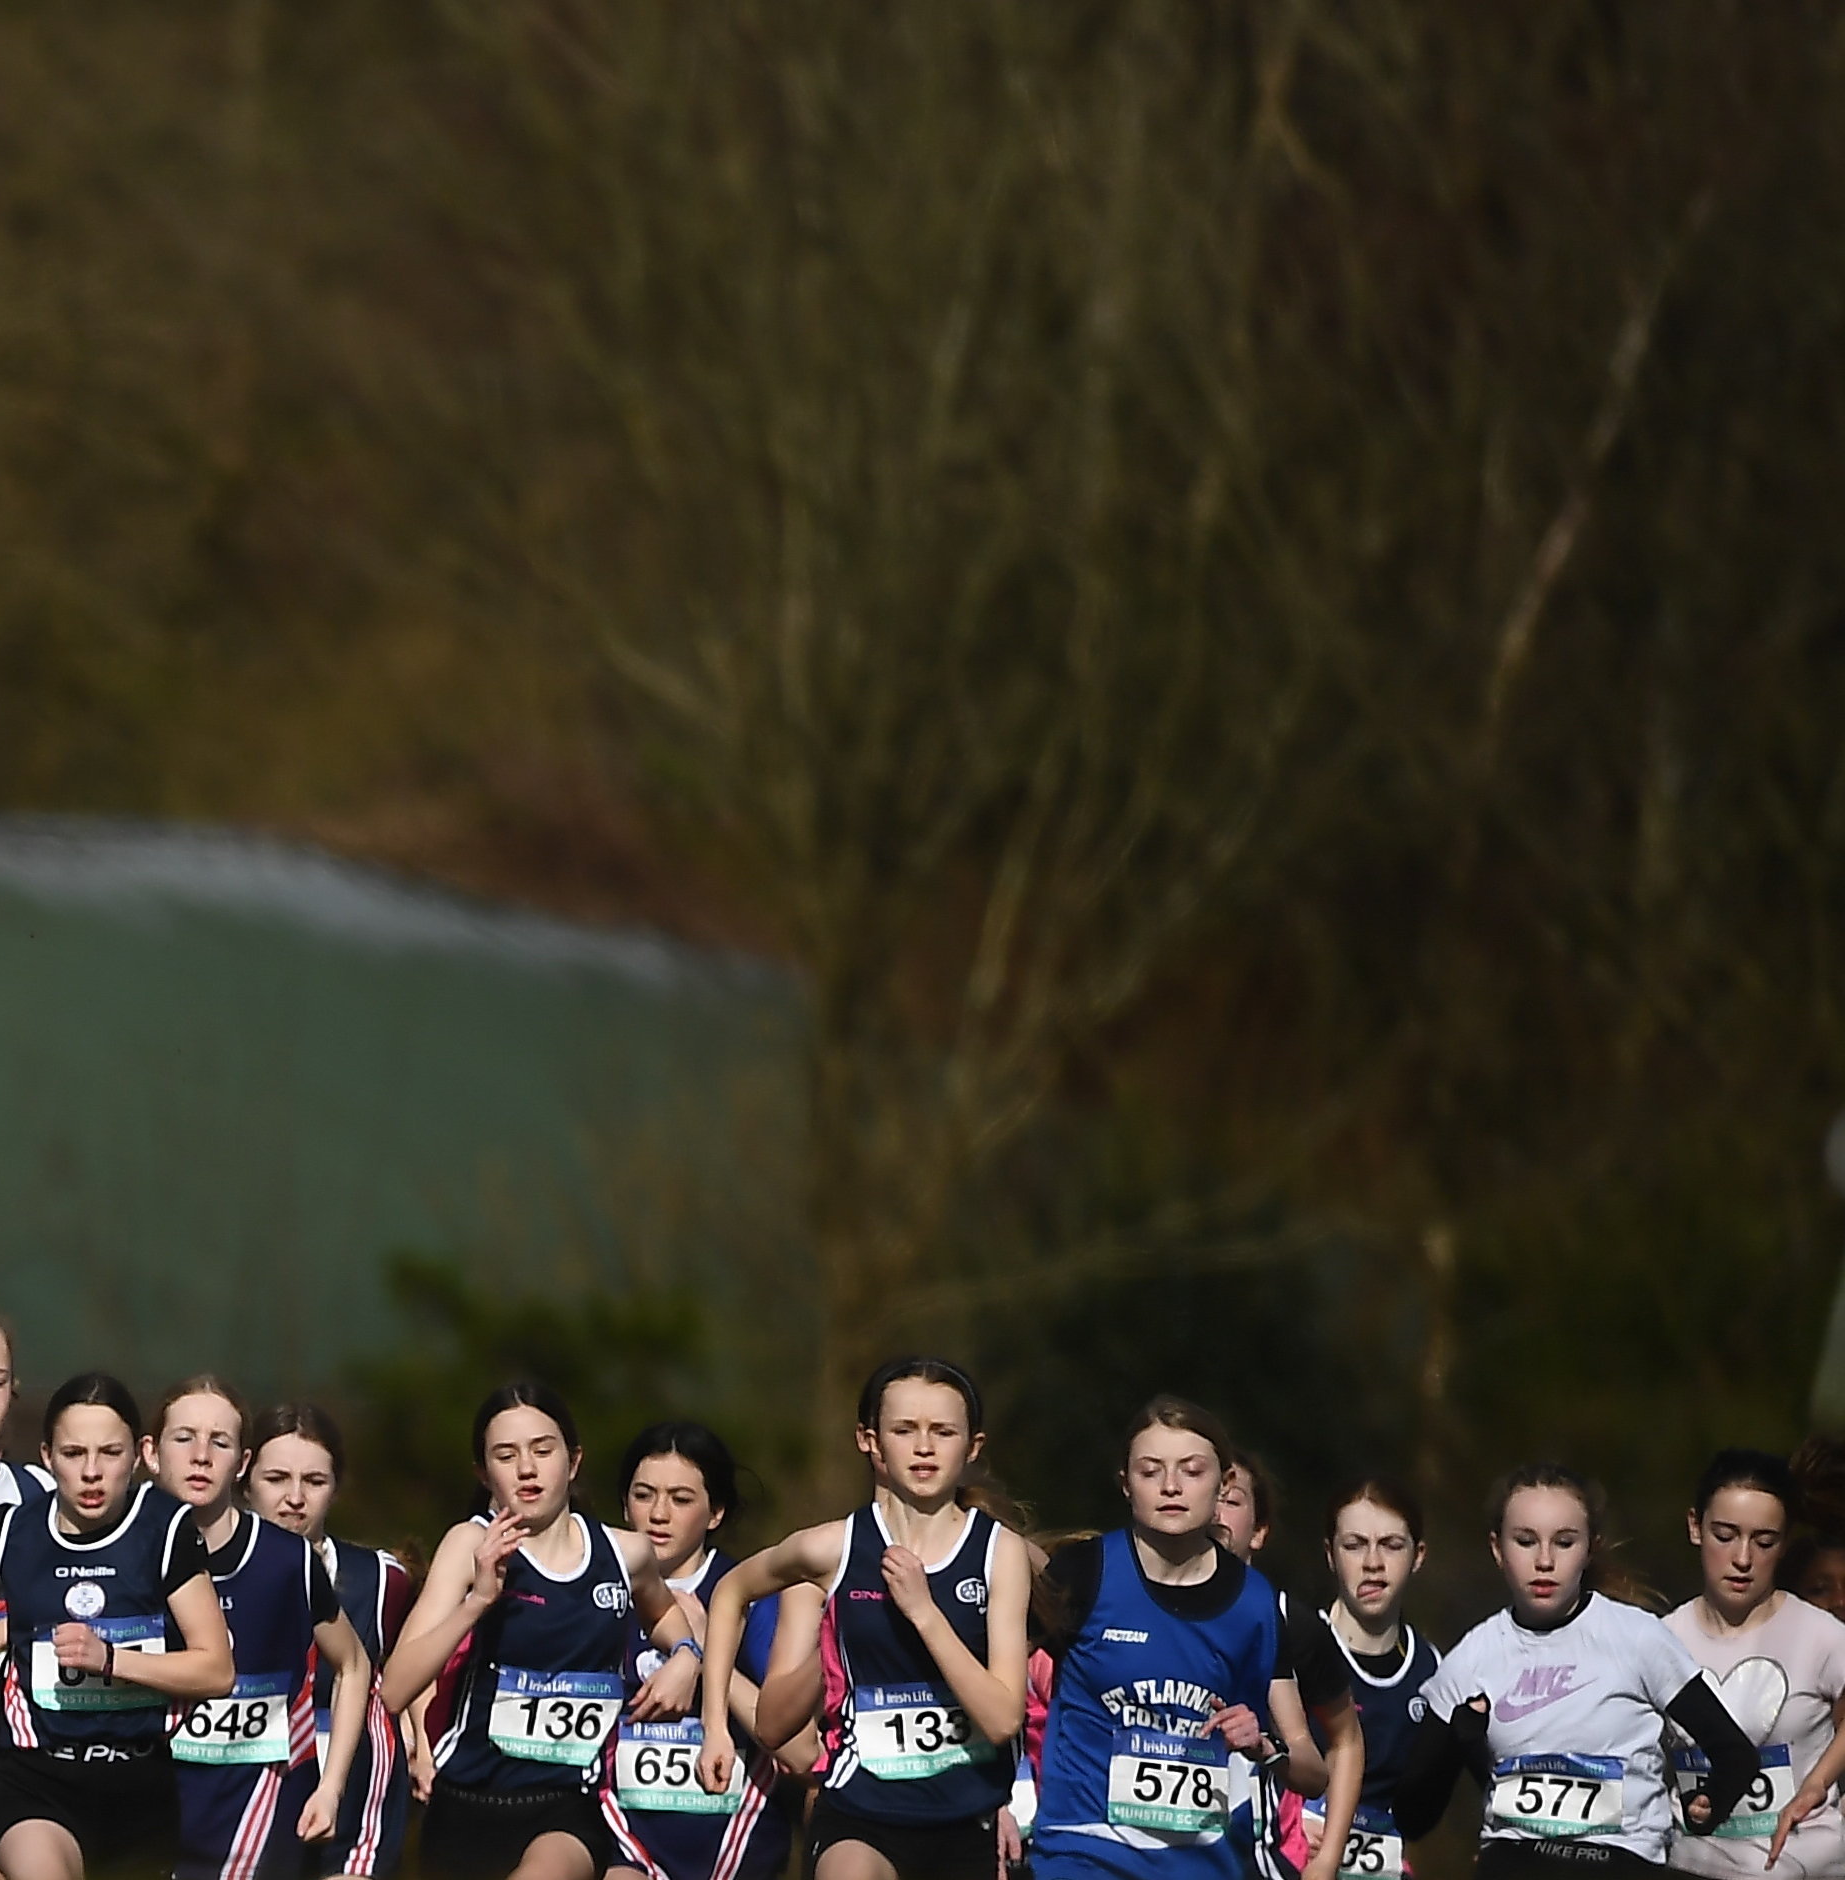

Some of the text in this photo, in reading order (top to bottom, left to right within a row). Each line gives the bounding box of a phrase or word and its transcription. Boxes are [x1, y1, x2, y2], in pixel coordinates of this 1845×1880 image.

[110, 1624, 148, 1639] health
[552, 1677, 573, 1693] Life
[574, 1680, 611, 1694] health
[886, 1690, 934, 1703] Irish Life
[1512, 1665, 1577, 1697] NIKE
[185, 1701, 269, 1741] 648
[519, 1698, 604, 1741] 136
[173, 1742, 224, 1757] UNSTER
[1142, 1740, 1169, 1755] Irish
[1169, 1742, 1187, 1757] Life
[634, 1747, 704, 1787] 65
[1133, 1761, 1213, 1809] 578
[1515, 1776, 1602, 1821] 577
[1342, 1833, 1385, 1874] 35
[1534, 1840, 1610, 1862] NIKE PRO
